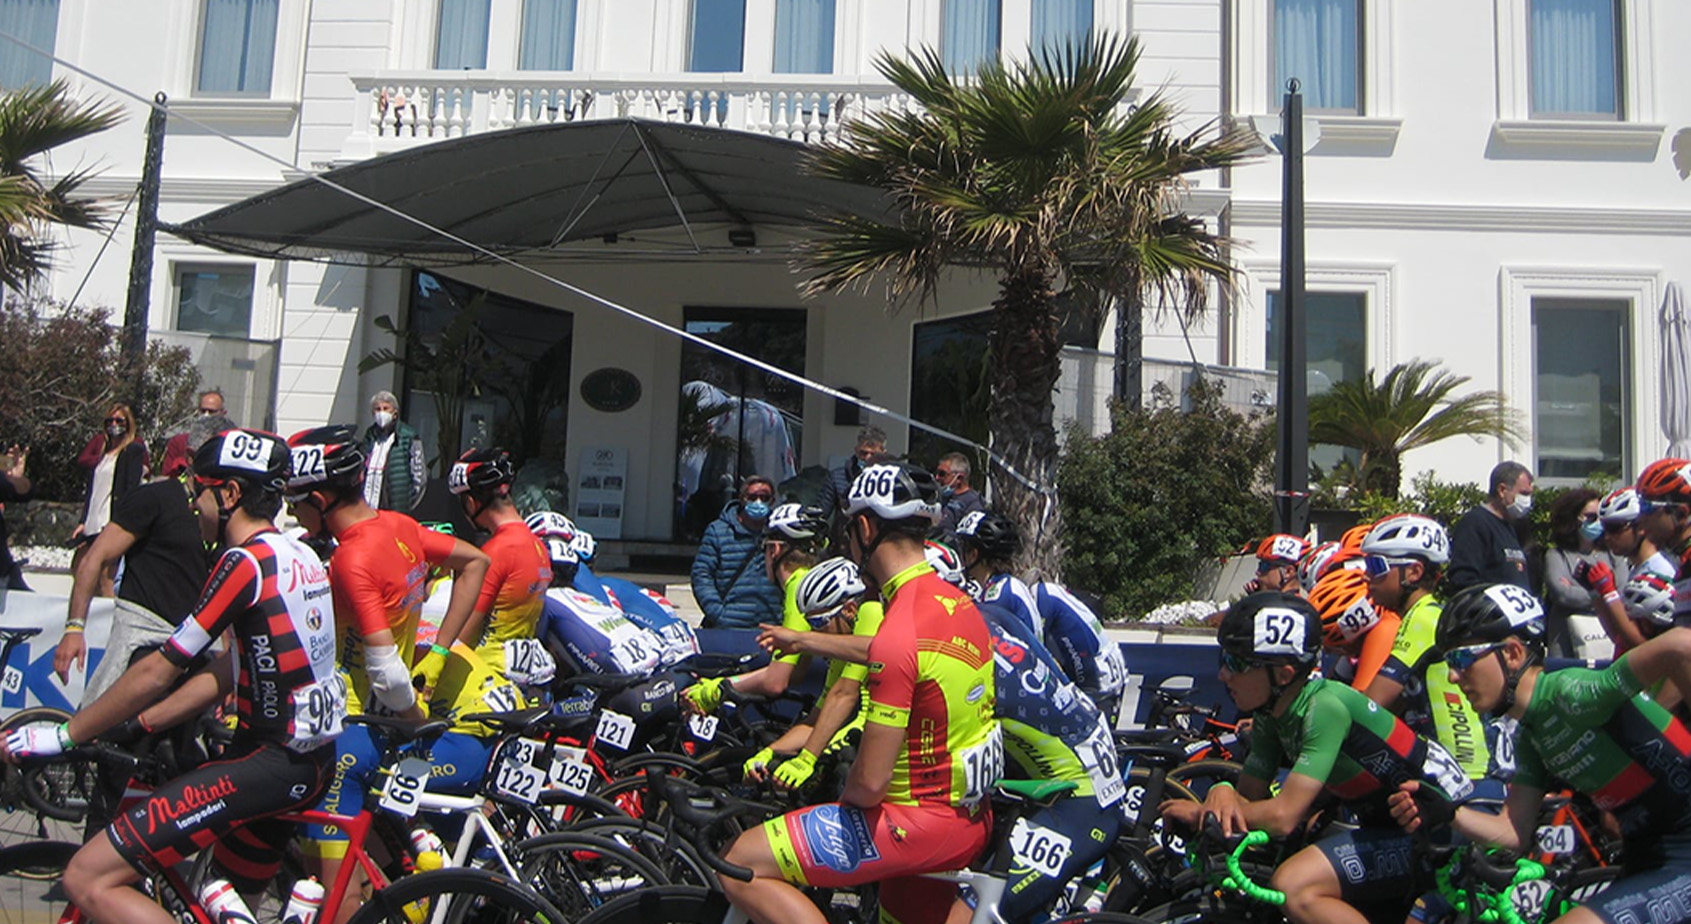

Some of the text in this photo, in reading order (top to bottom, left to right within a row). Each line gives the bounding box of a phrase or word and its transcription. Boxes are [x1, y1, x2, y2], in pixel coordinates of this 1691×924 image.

[231, 434, 263, 461] 99
[852, 469, 894, 498] 166
[1500, 587, 1536, 614] 53
[1264, 614, 1296, 645] 52
[1345, 606, 1371, 633] 93
[621, 637, 647, 665] 18
[6, 671, 20, 689] 43
[252, 634, 279, 718] PACI PAOLO
[309, 685, 334, 736] 99
[599, 720, 627, 745] 121
[697, 716, 713, 737] 18
[430, 763, 457, 778] RO
[500, 766, 536, 798] 122
[557, 762, 588, 790] 125
[323, 753, 358, 836] SALIGERO
[390, 773, 420, 805] 66
[147, 774, 237, 835] Maltinti
[175, 799, 228, 830] lampadari
[1018, 831, 1065, 870] 166
[1544, 827, 1567, 851] 64
[1516, 881, 1542, 914] 52
